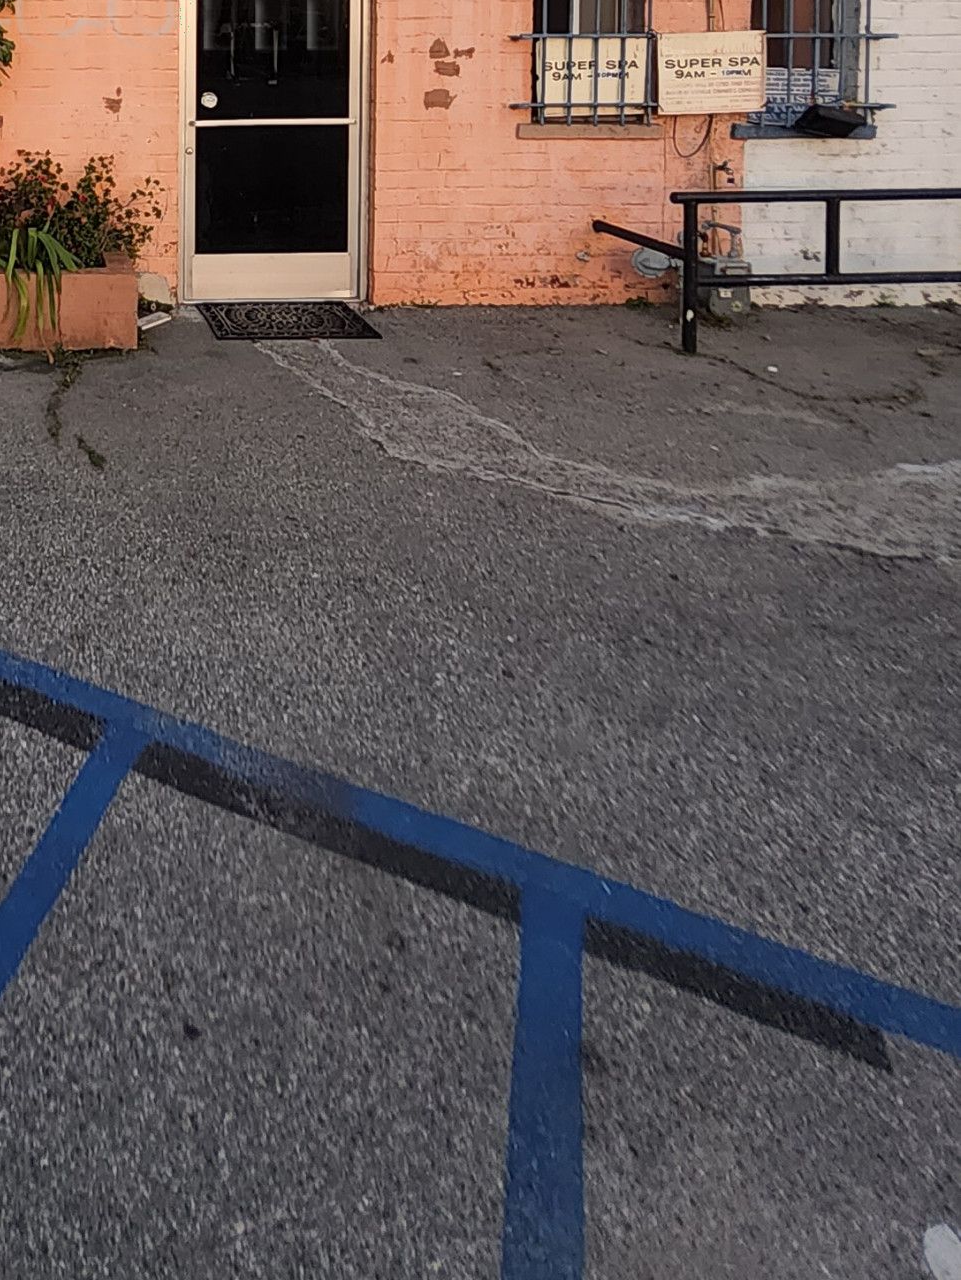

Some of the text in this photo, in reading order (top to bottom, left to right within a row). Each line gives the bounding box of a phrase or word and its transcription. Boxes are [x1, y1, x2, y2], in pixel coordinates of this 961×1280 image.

[664, 56, 761, 69] SUPER SPA
[674, 69, 706, 79] 9AM
